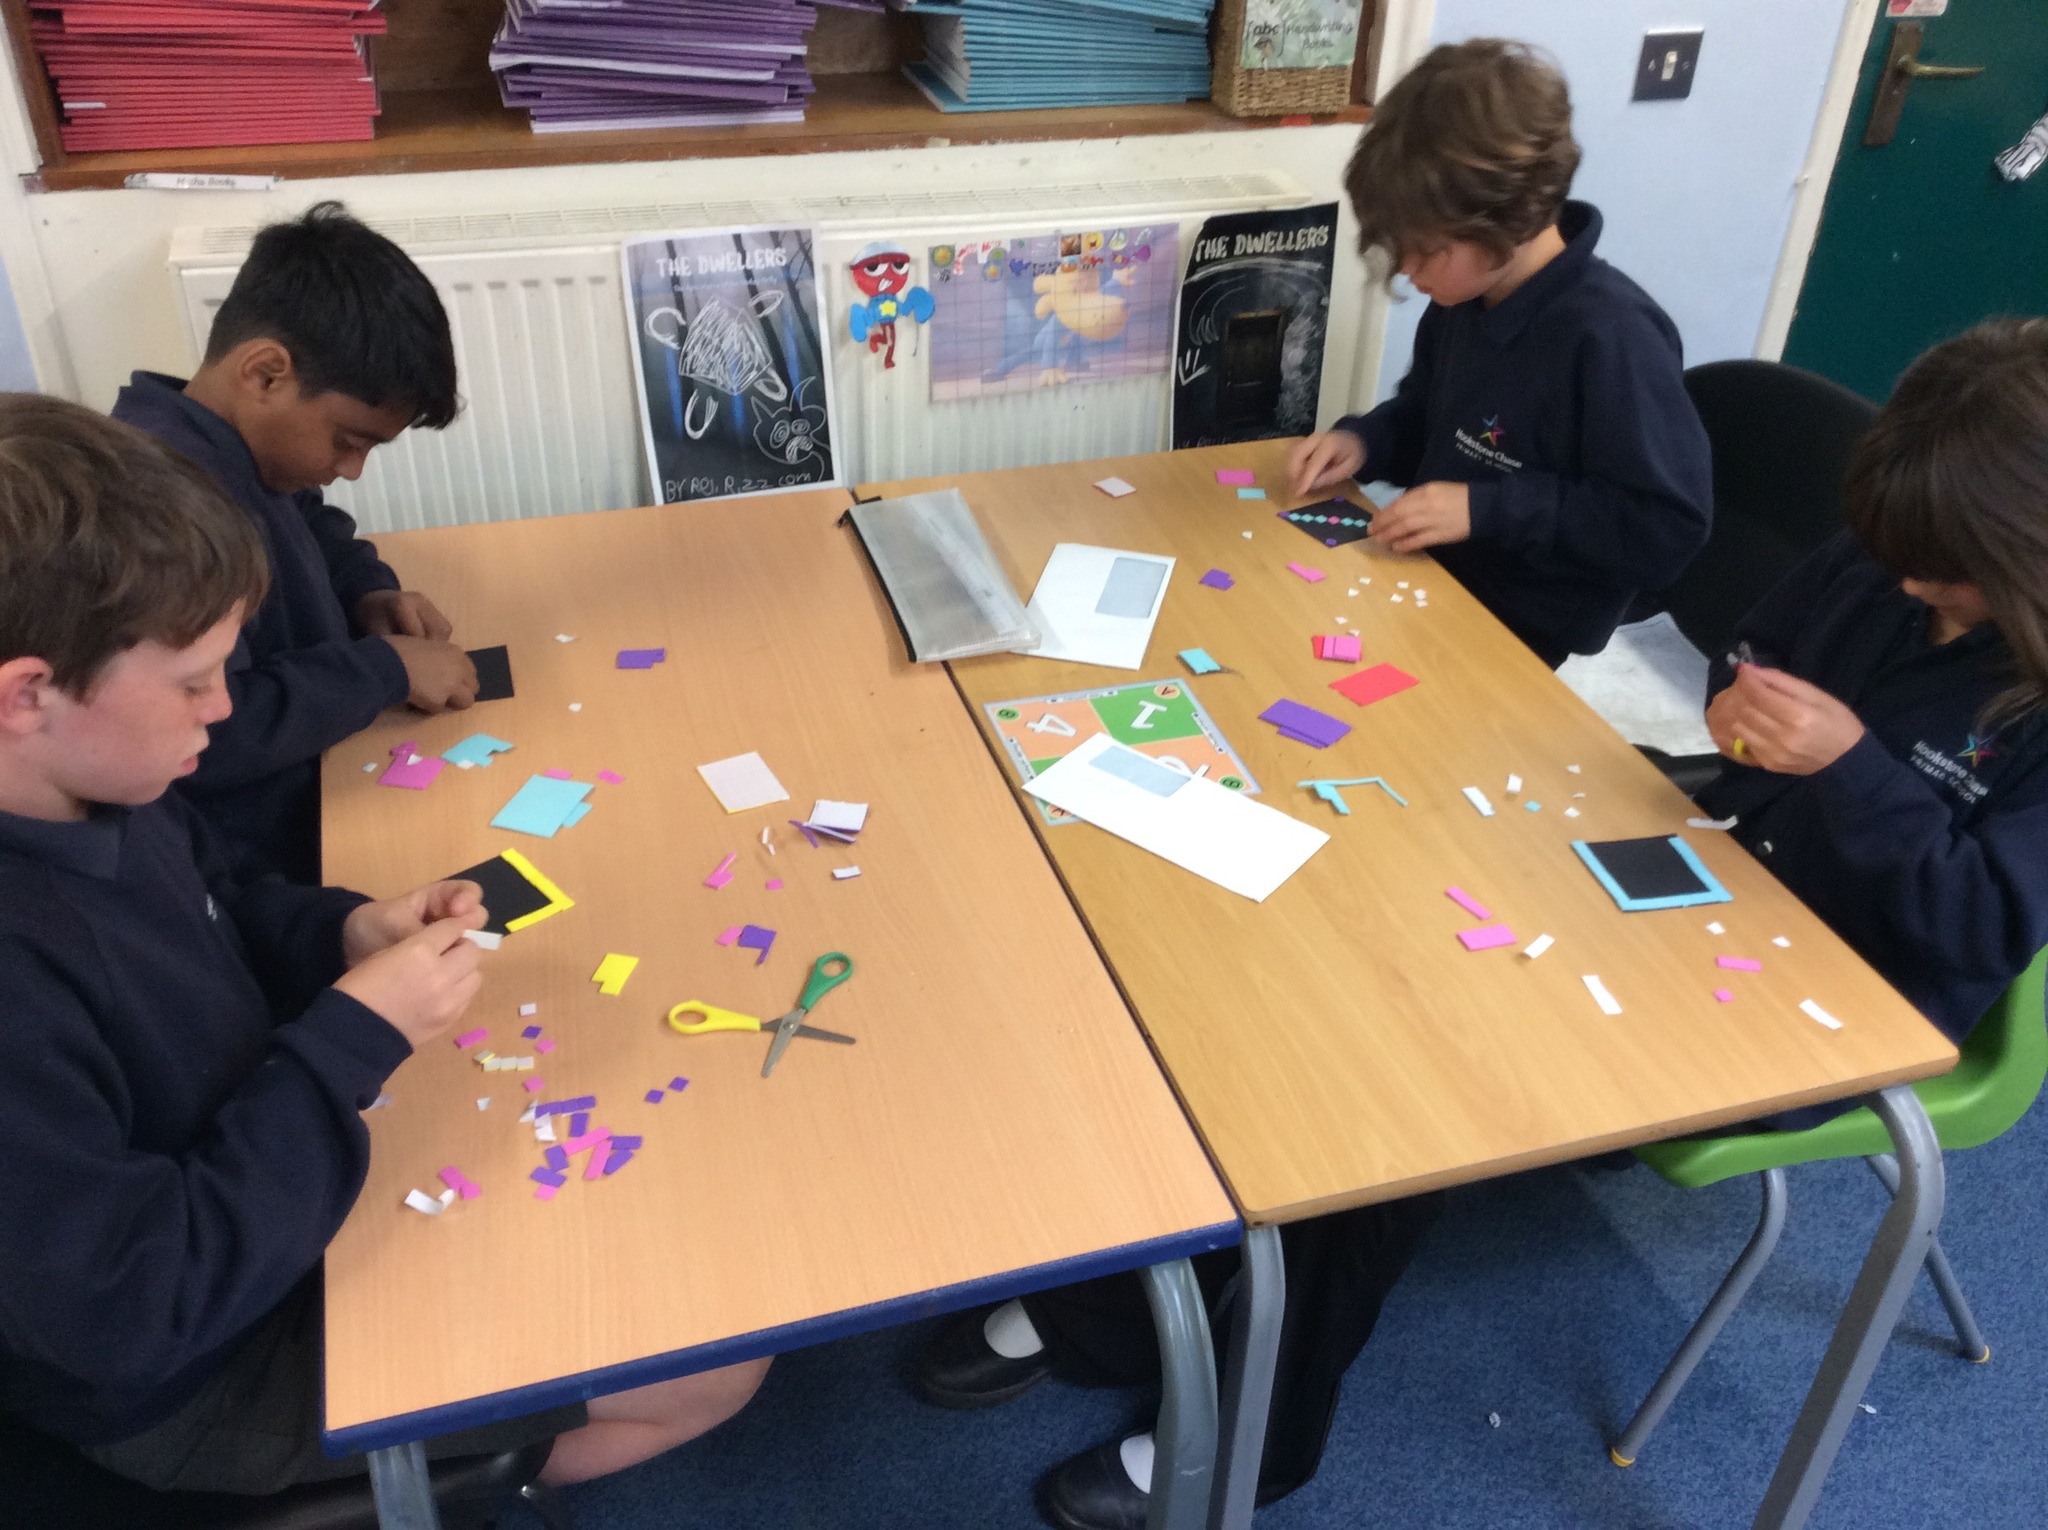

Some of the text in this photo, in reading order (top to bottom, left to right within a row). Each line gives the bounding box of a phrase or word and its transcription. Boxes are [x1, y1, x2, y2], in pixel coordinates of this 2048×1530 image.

[1195, 224, 1330, 262] THE DWELLERS
[656, 247, 788, 279] THE DWELLERS
[1025, 713, 1077, 738] 4
[1130, 699, 1169, 730] 1
